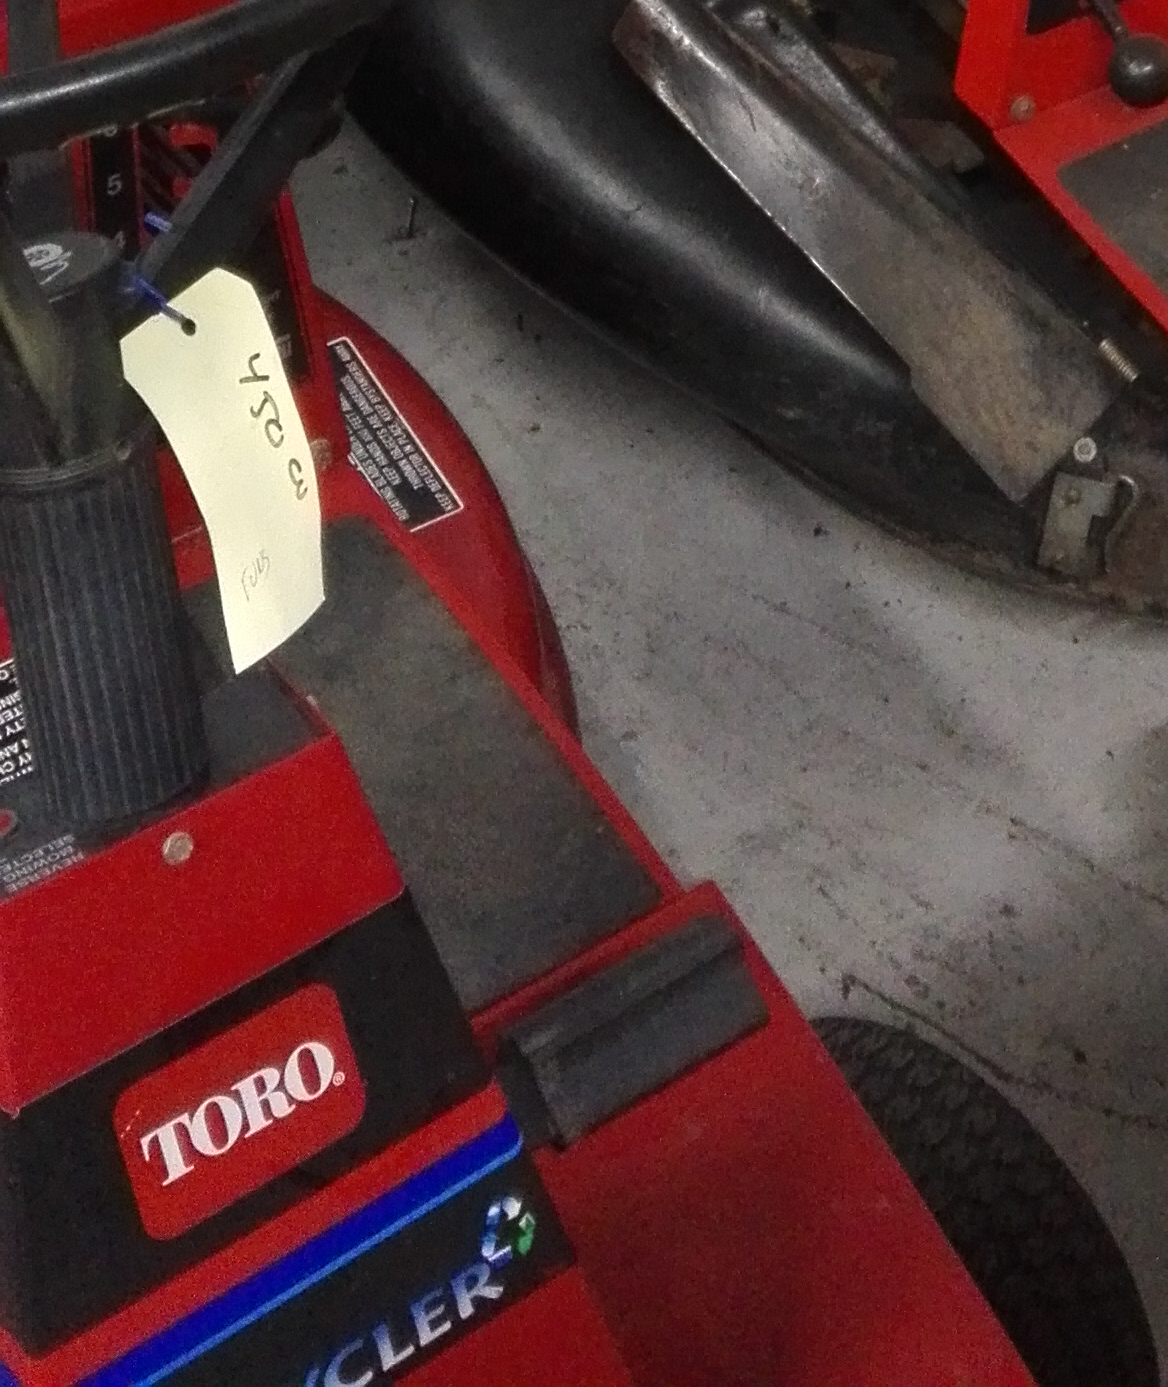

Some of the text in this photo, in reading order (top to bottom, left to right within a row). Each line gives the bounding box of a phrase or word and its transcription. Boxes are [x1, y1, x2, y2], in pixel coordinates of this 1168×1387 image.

[106, 174, 122, 197] 5
[382, 465, 402, 486] KEEP
[435, 491, 454, 512] KEEP
[140, 1041, 335, 1187] TORO
